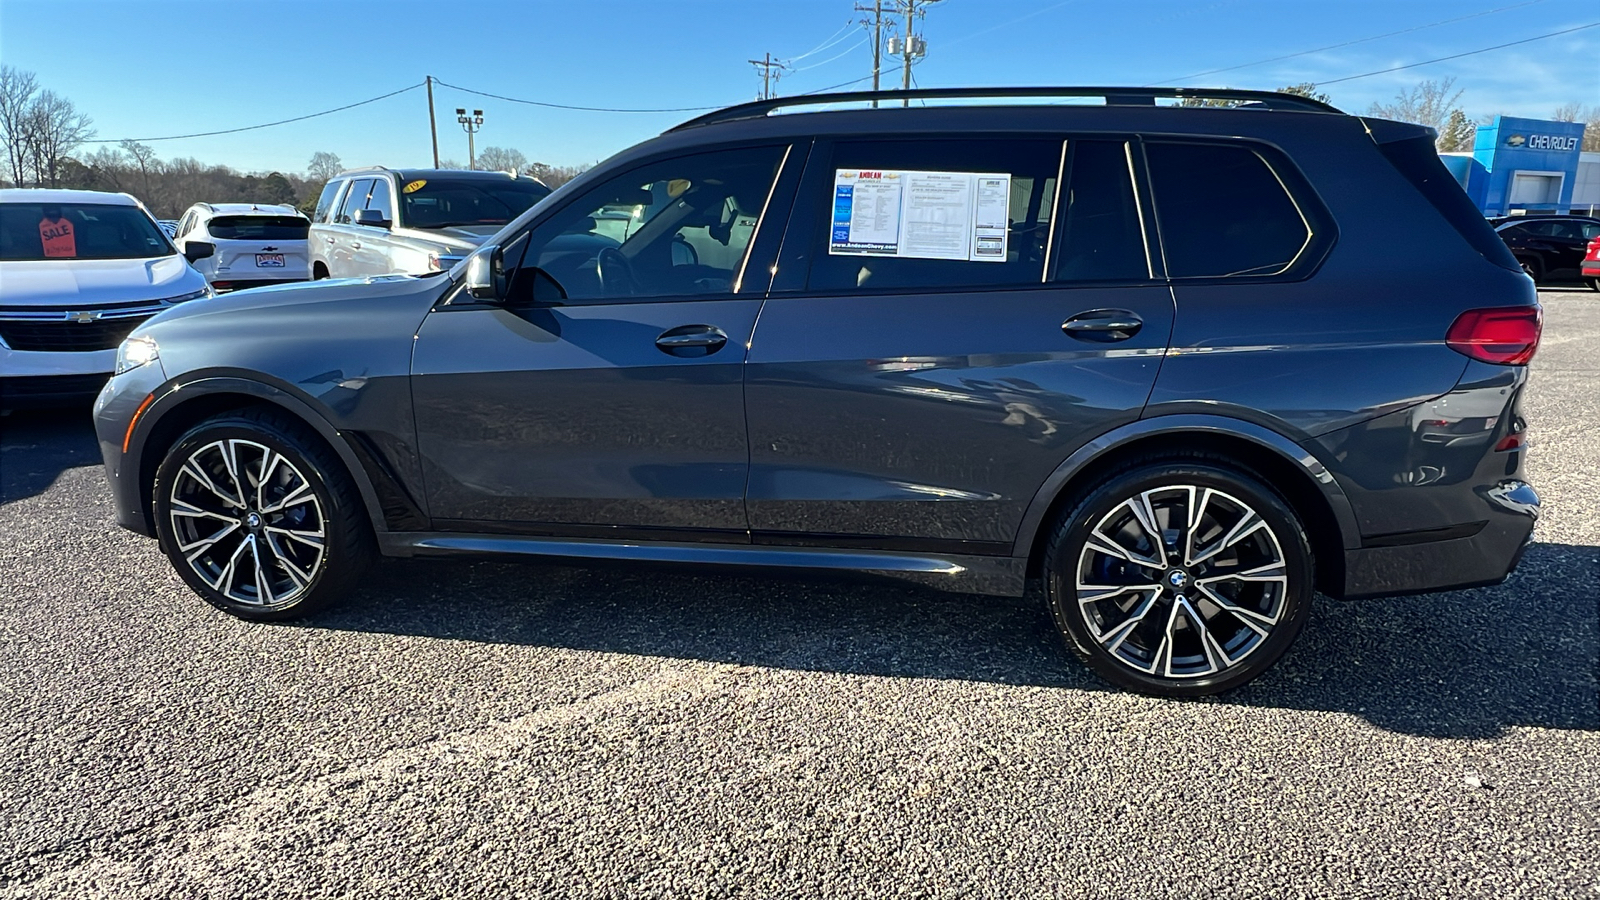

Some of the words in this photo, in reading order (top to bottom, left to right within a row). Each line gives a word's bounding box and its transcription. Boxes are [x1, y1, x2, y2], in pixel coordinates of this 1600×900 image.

[1529, 134, 1578, 151] CHEVROLET
[859, 171, 882, 180] ANDEAN
[409, 182, 420, 191] 19
[43, 224, 71, 241] SALE
